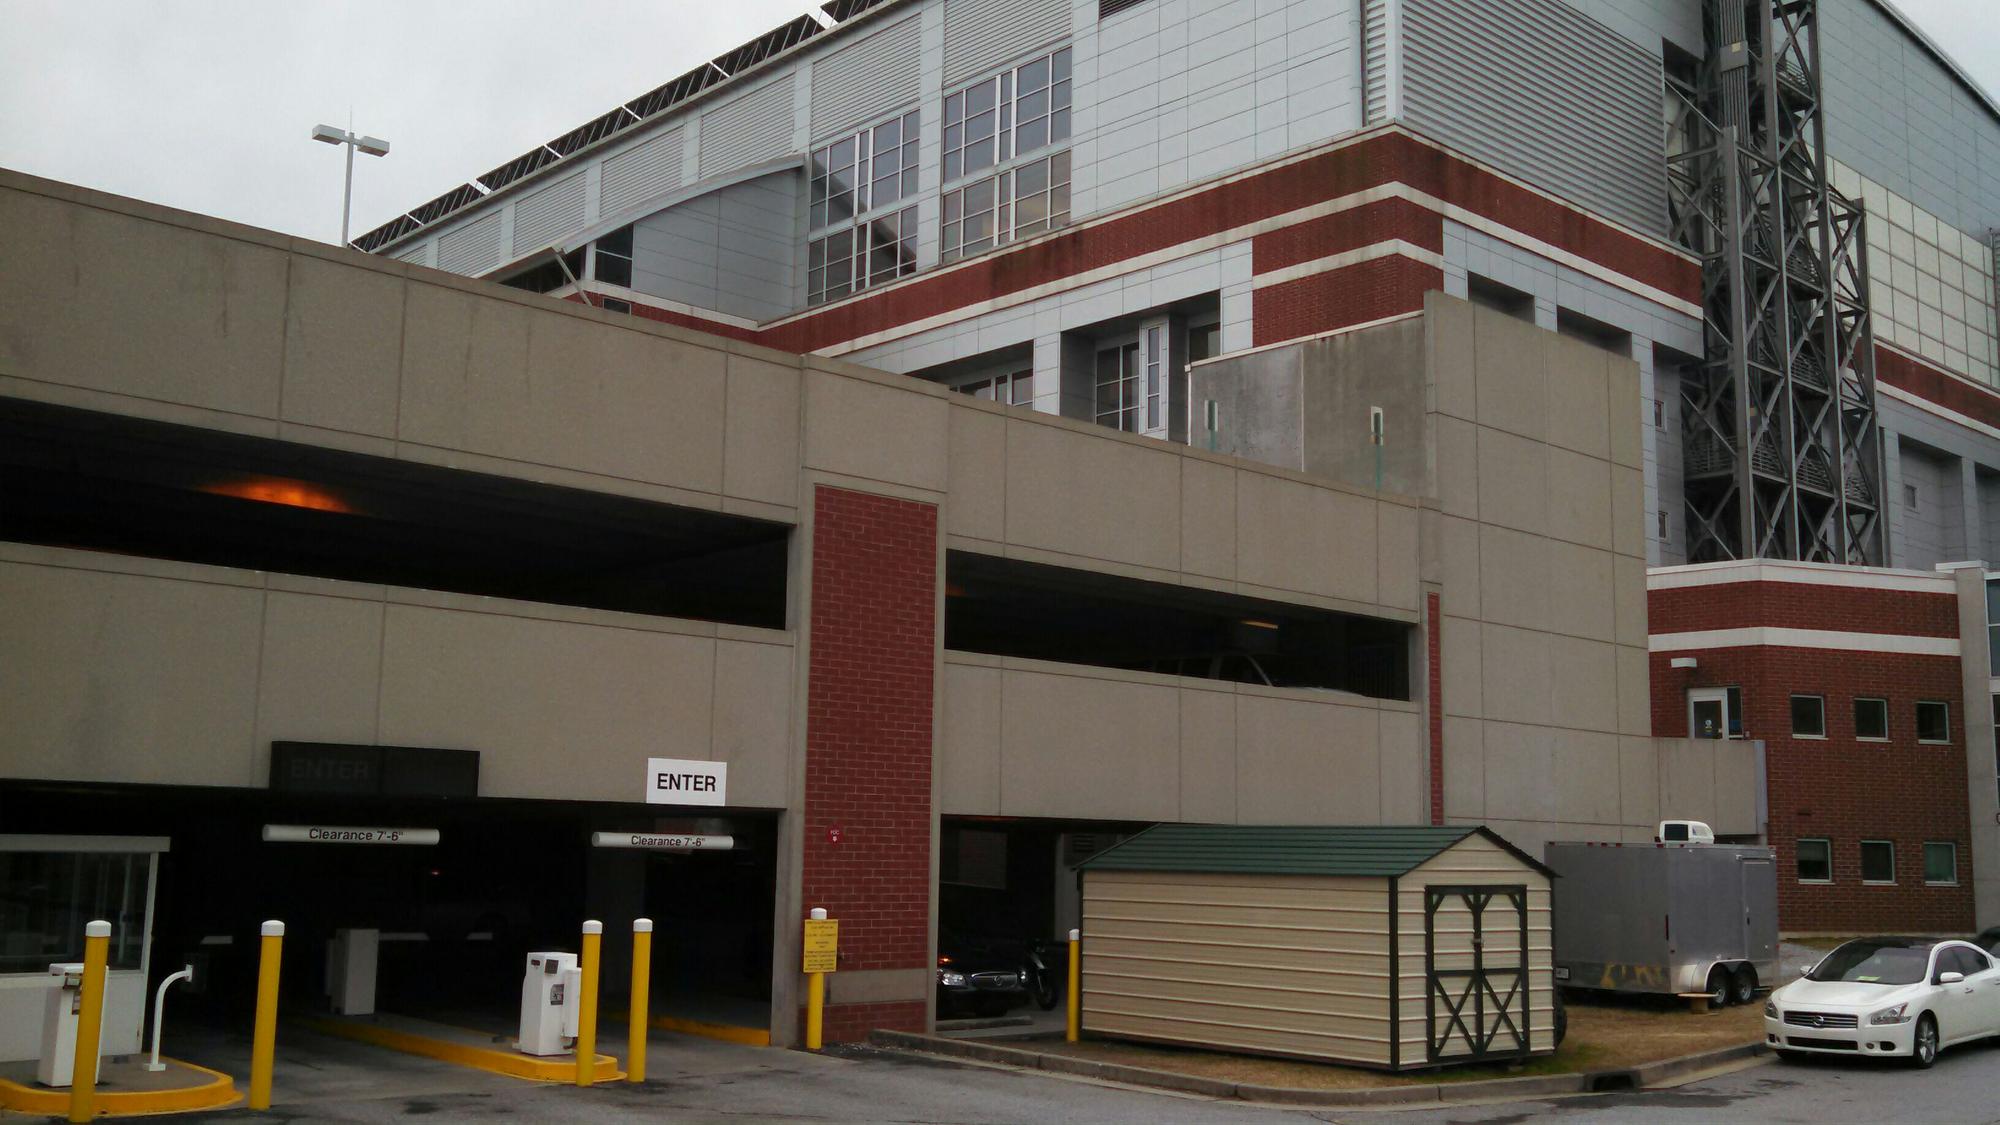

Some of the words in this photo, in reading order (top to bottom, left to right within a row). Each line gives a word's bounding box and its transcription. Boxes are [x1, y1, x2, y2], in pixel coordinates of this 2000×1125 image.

[291, 759, 369, 779] ENTER
[657, 773, 716, 792] ENTER
[309, 828, 373, 840] Clearance
[631, 835, 681, 846] Clearance
